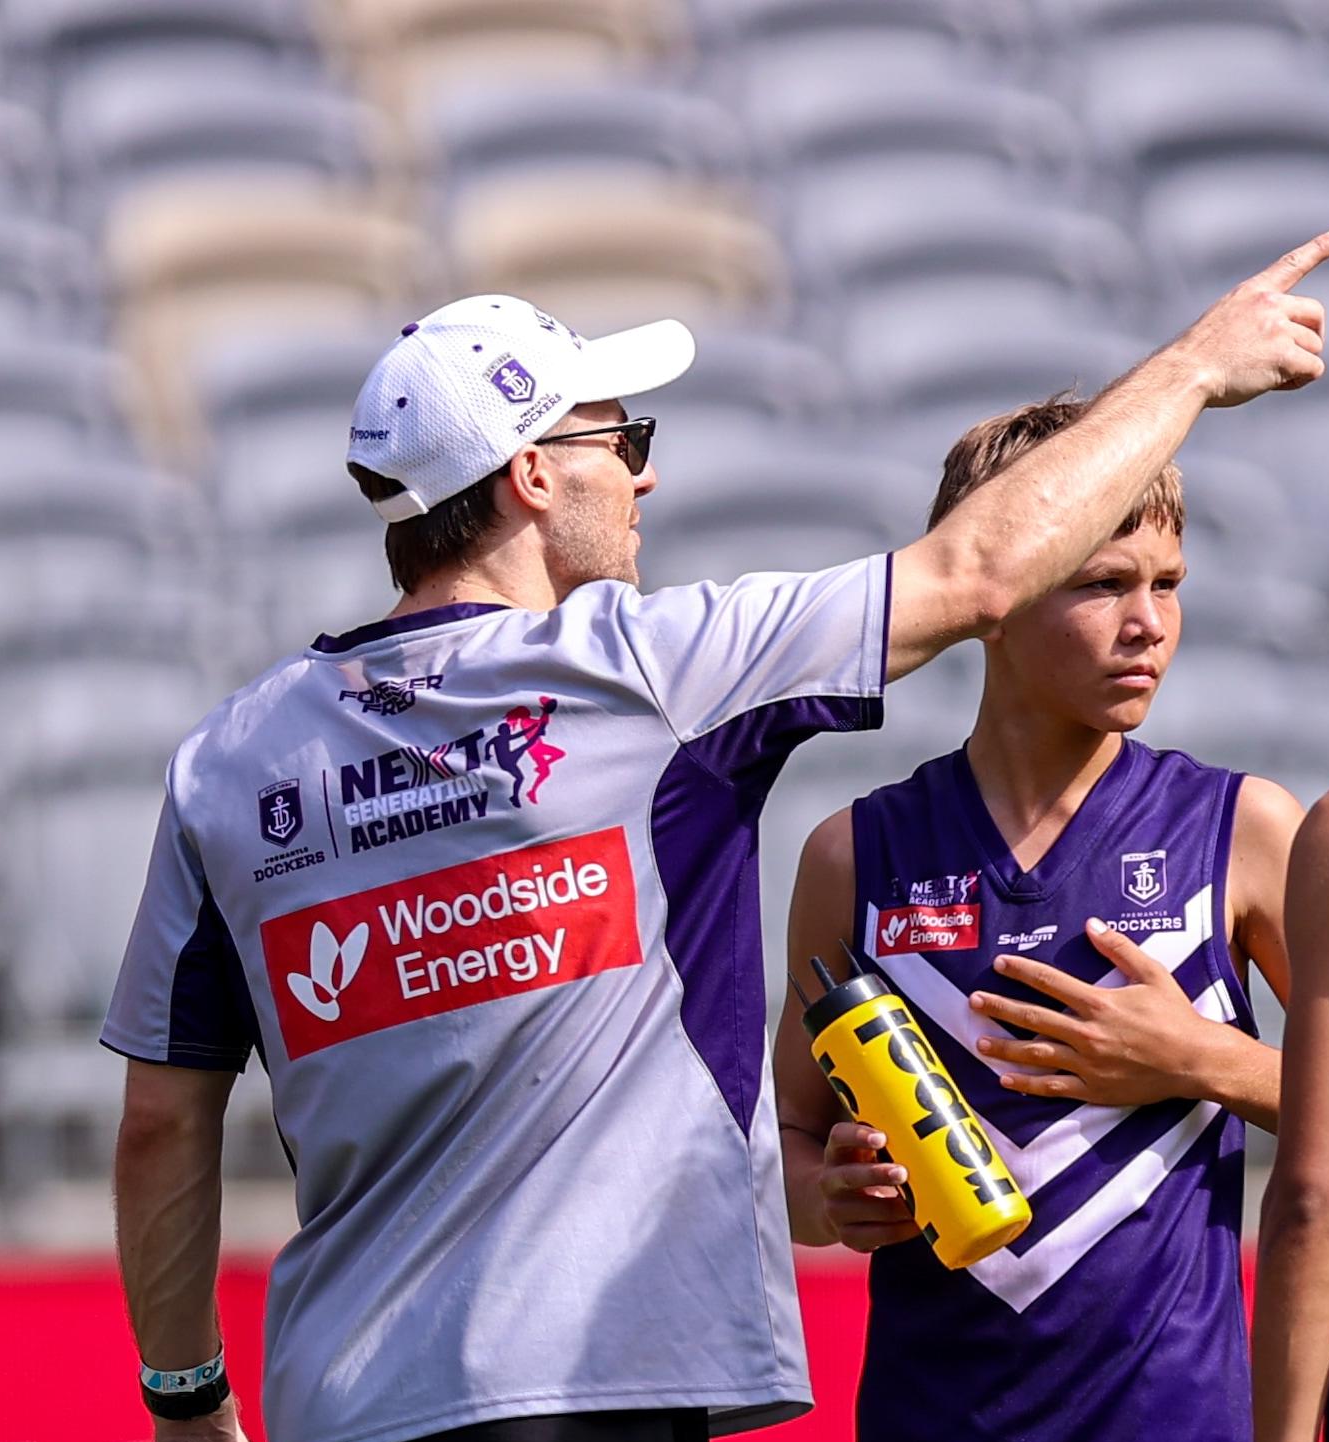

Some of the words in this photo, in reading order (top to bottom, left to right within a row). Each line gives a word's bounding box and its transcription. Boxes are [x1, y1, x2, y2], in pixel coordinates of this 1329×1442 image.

[338, 674, 445, 703] FOREVER
[340, 728, 486, 804] NEXT
[344, 773, 489, 826] GENERATION
[352, 791, 489, 853] ACADEMY
[253, 850, 326, 882] DOCKERS
[378, 857, 609, 945] Woodside
[909, 911, 974, 928] Woodside
[909, 930, 958, 946] Energy
[997, 931, 1054, 946] Sekem
[1106, 917, 1183, 932] DOCKERS
[394, 927, 566, 1000] Energy
[854, 1007, 1017, 1206] rebel
